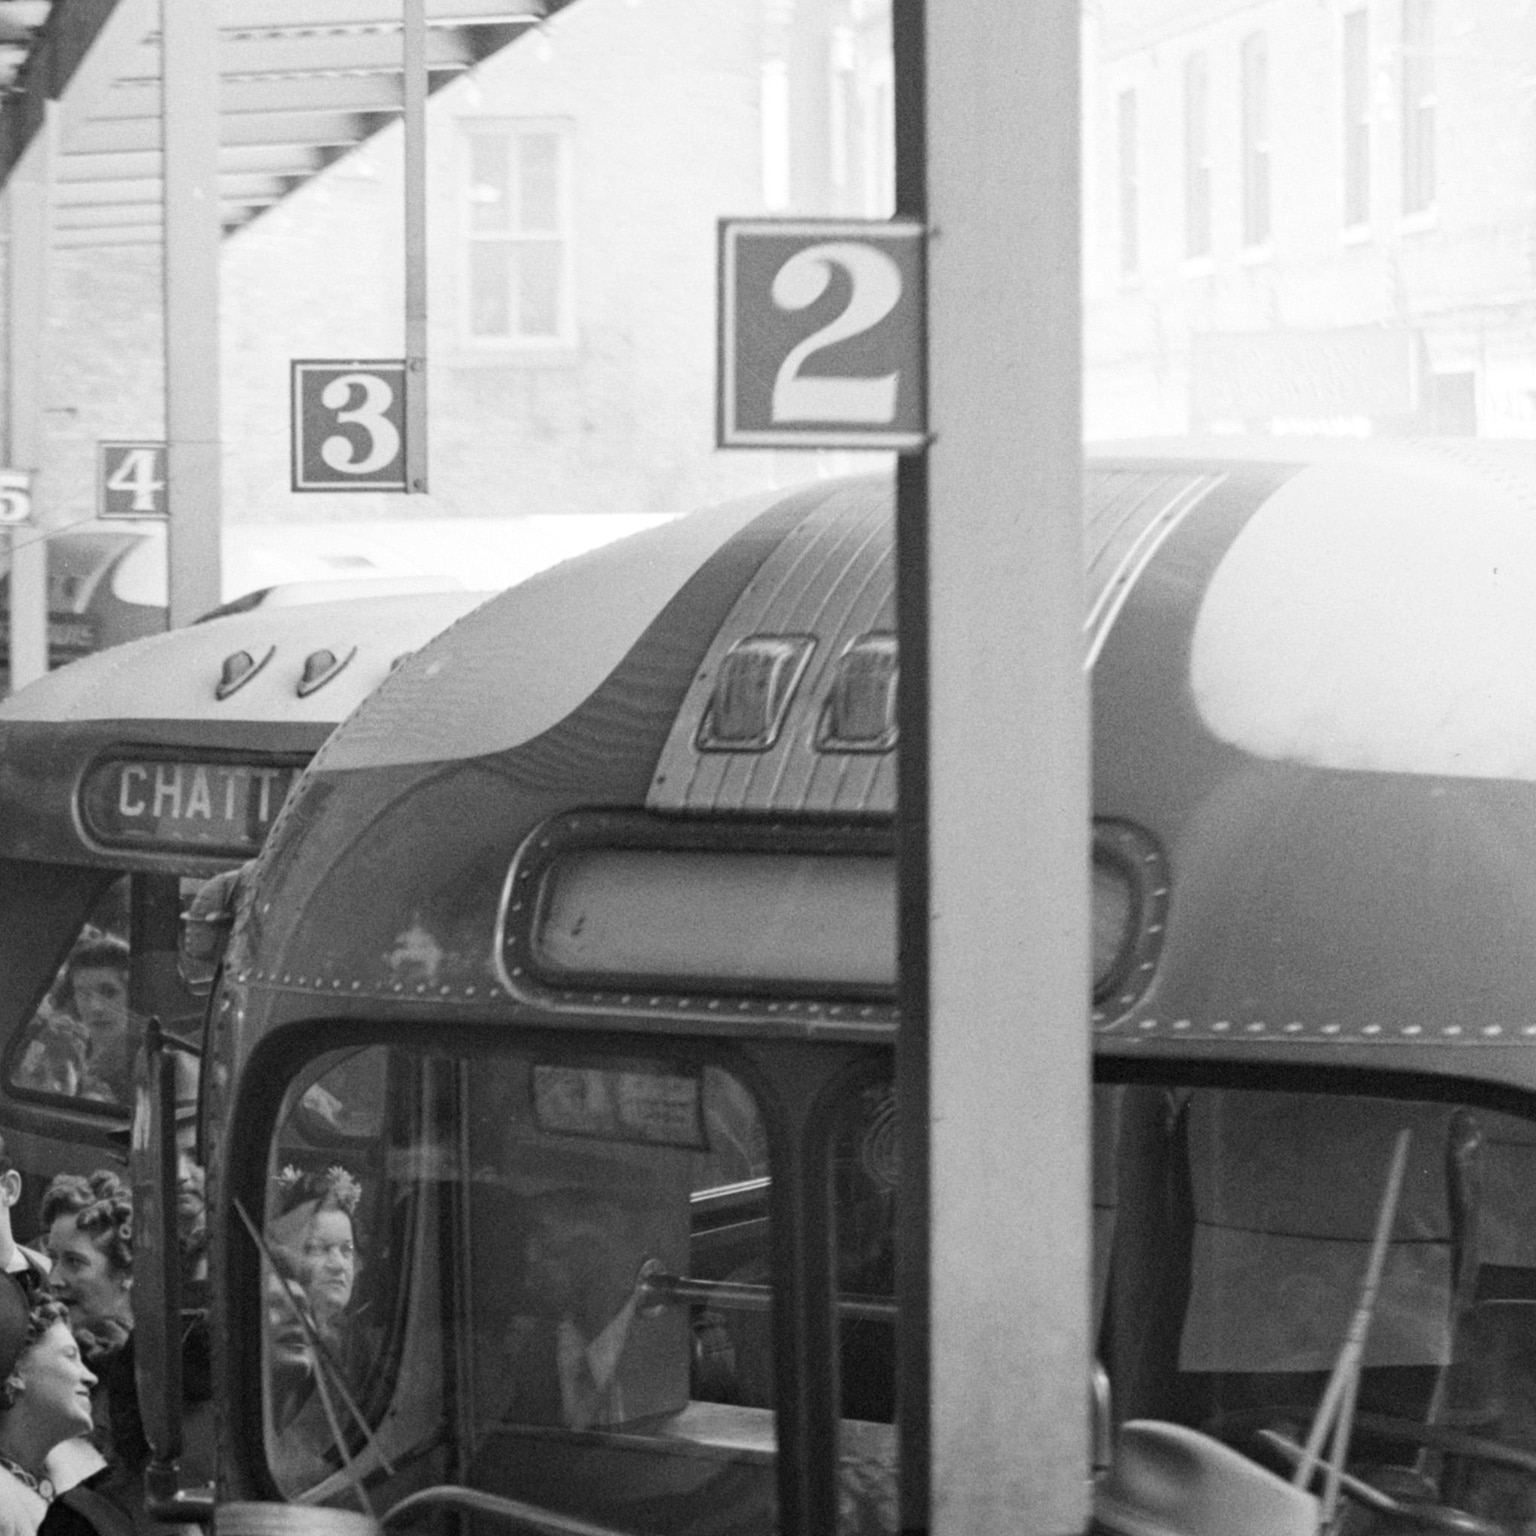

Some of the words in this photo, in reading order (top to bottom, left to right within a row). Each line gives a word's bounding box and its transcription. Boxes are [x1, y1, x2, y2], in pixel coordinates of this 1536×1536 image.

[770, 242, 903, 424] 2
[321, 373, 400, 474] 3
[107, 449, 164, 511] 4
[118, 765, 304, 822] CHATT
